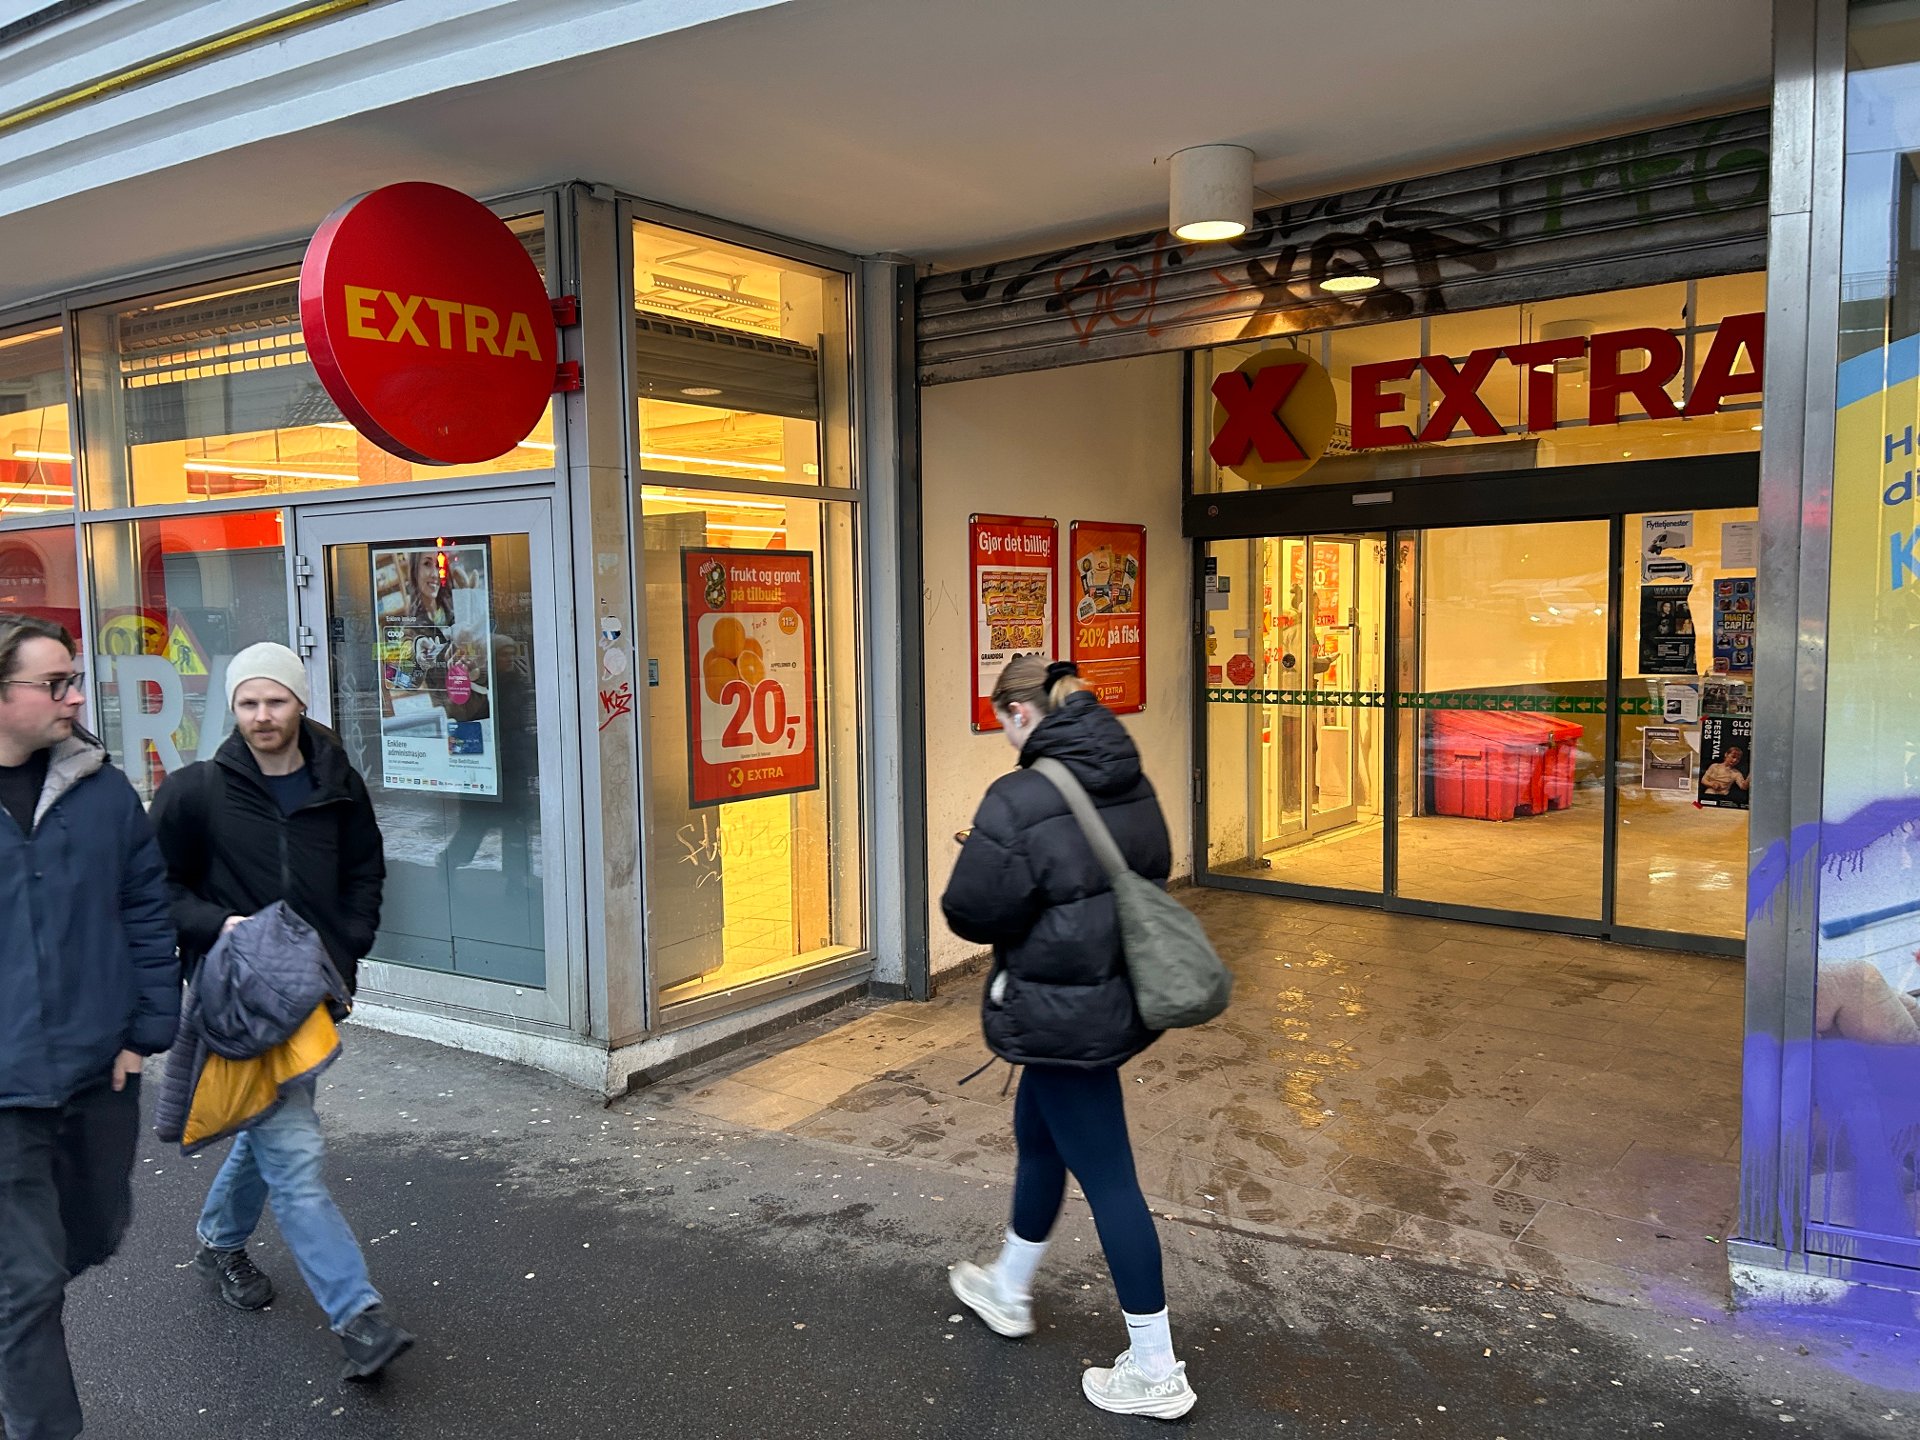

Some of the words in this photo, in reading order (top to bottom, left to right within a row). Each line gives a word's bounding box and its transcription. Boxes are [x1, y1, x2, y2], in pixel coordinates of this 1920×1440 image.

[344, 284, 543, 362] EXTRA
[1351, 311, 1766, 449] EXTRA
[1884, 425, 1920, 464] H
[1646, 519, 1690, 530] Flyttetjenester
[979, 531, 1003, 555] Gjør
[1004, 533, 1023, 552] det
[1023, 535, 1051, 557] billig!
[730, 566, 757, 582] frukt
[759, 570, 772, 586] og
[773, 569, 801, 586] grønt
[730, 587, 745, 604] på
[747, 586, 782, 602] tilbud!
[1076, 627, 1106, 648] -20%
[1107, 625, 1120, 649] på
[1121, 624, 1140, 644] fisk
[1105, 686, 1123, 695] EXTRA
[1704, 719, 1713, 740] 2025
[387, 740, 407, 748] Enklere
[1712, 720, 1722, 760] FESTIVAL
[387, 749, 427, 759] administrasjon
[747, 766, 784, 781] EXTRA
[1144, 1379, 1179, 1399] HOKA
